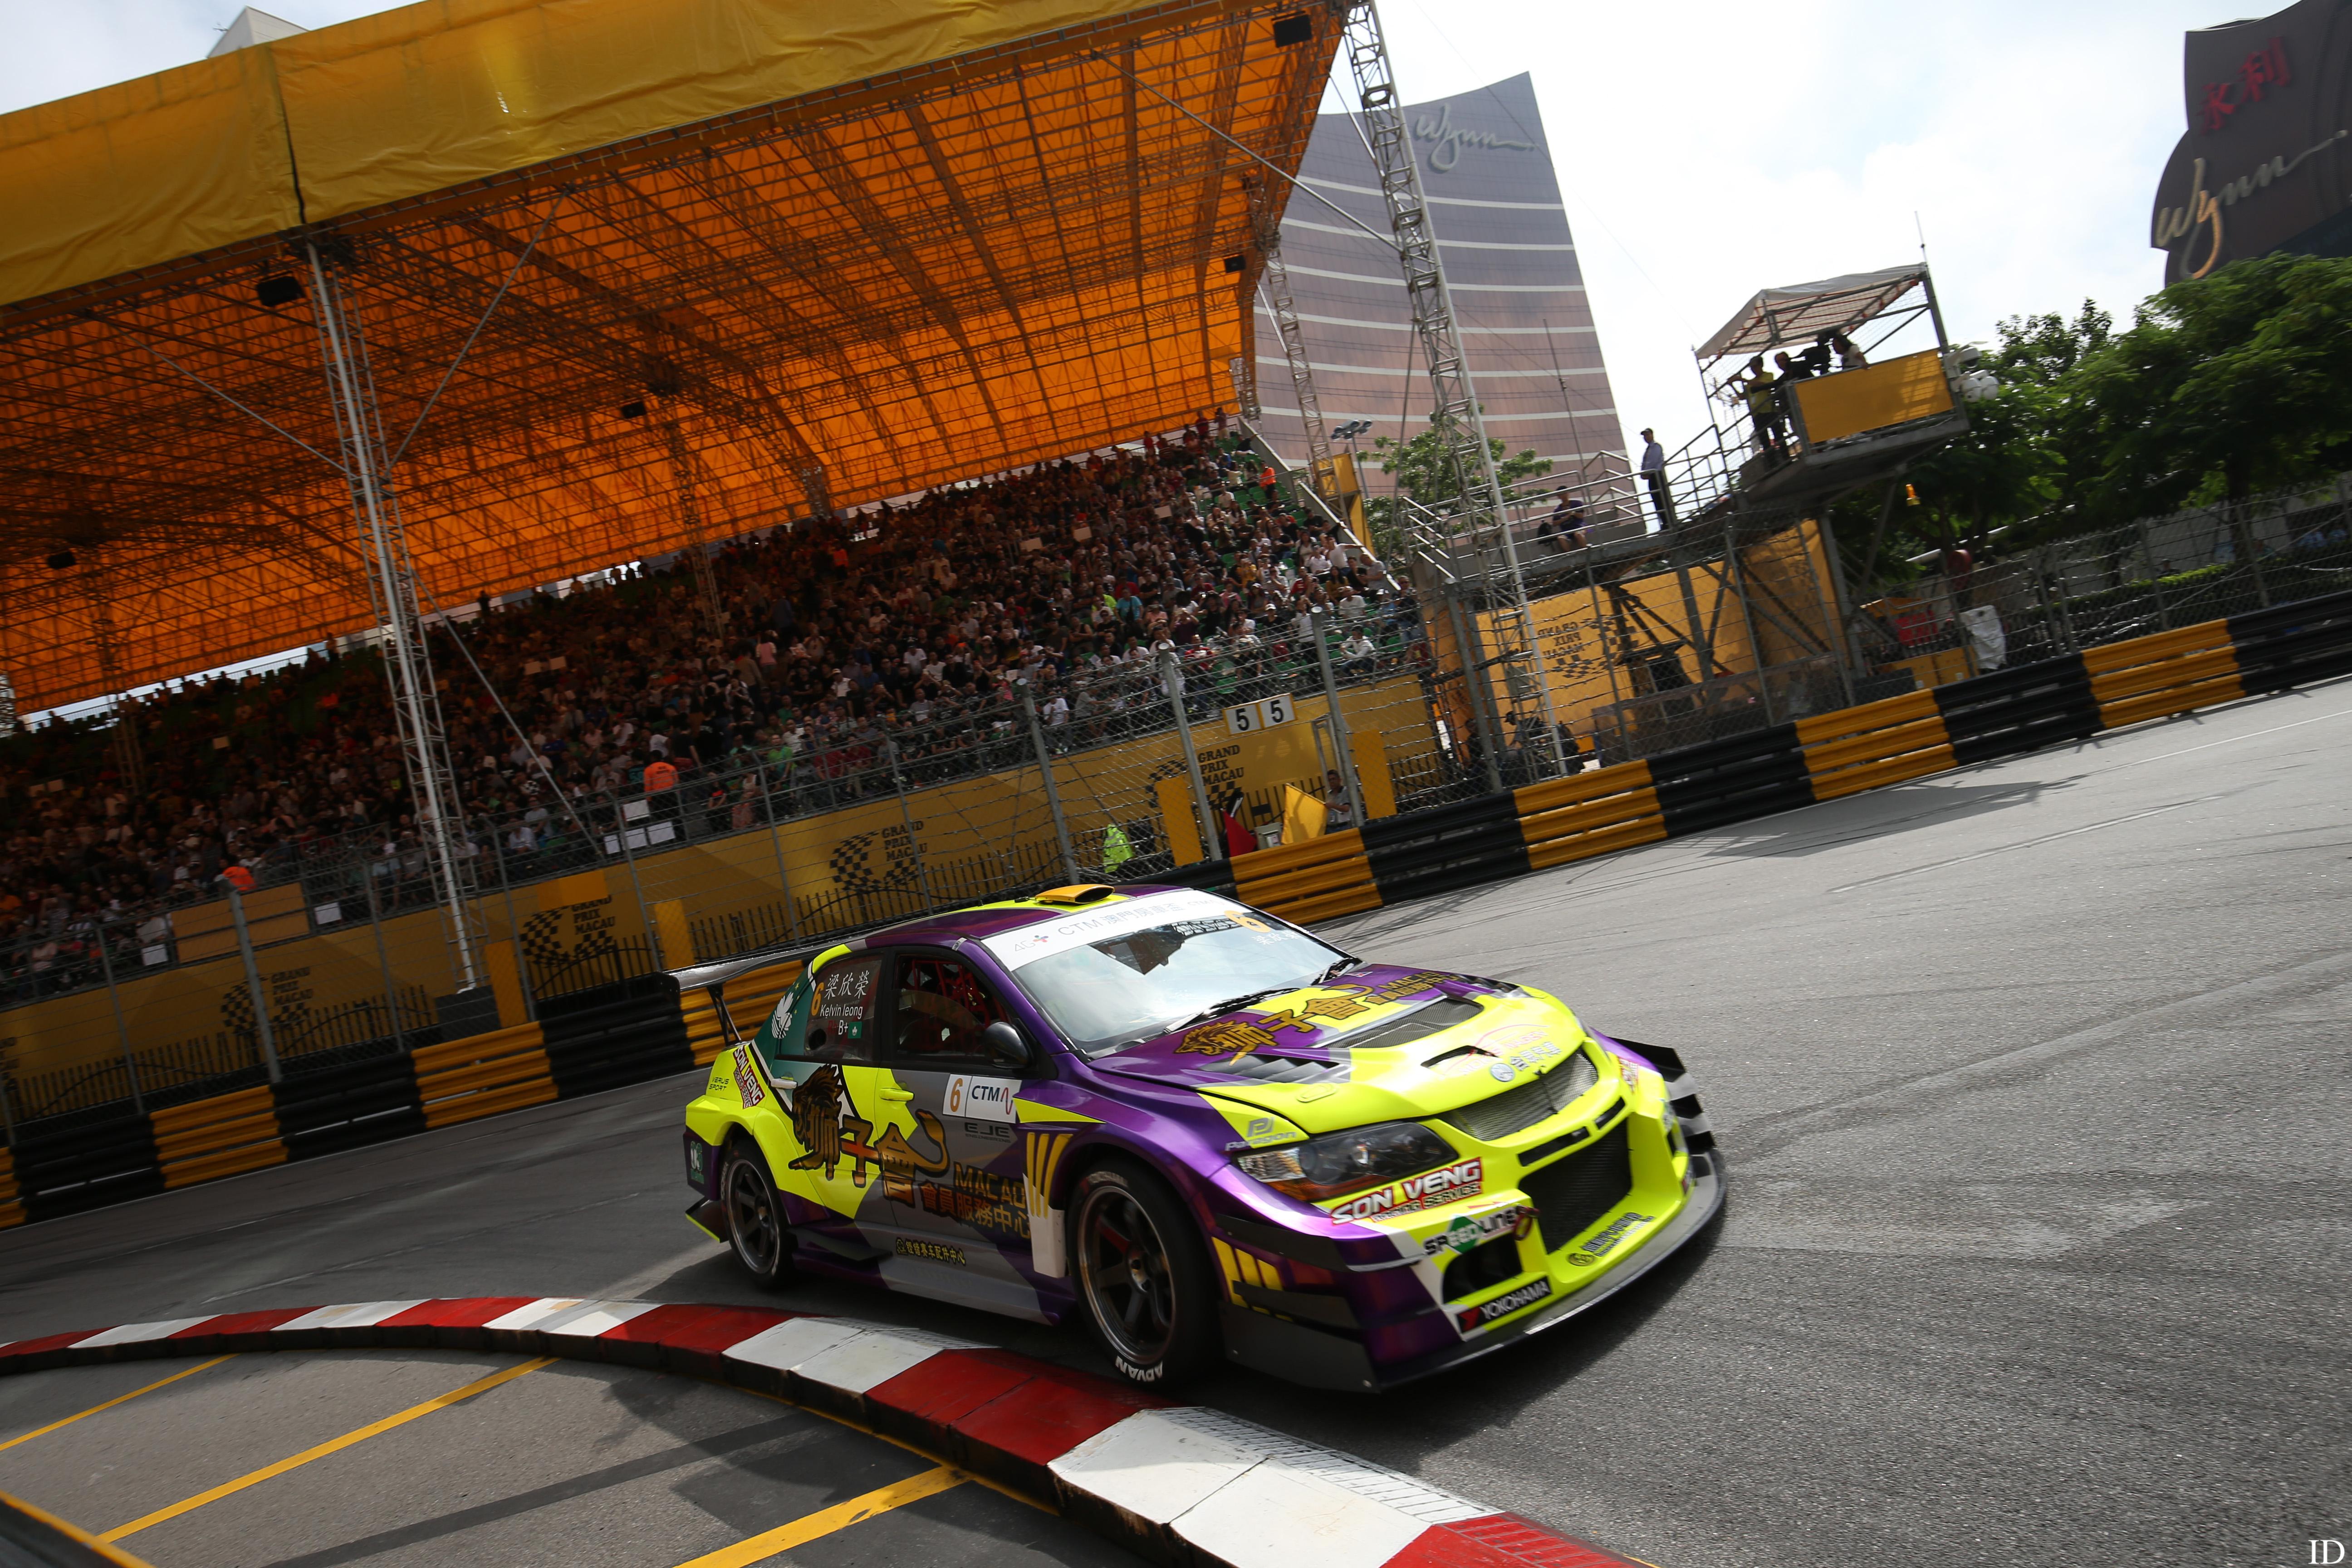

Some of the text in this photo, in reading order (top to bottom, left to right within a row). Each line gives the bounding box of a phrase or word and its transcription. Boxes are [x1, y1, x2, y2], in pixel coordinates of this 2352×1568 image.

[2195, 36, 2291, 134] 永利
[1236, 699, 1284, 731] 5 5
[1198, 745, 1240, 763] GRAND
[1200, 759, 1229, 774] PRIX
[1202, 767, 1244, 786] MACAU
[887, 843, 928, 861] MACU
[573, 908, 602, 923] PRIX
[1224, 909, 1271, 933] 6
[574, 916, 616, 935] MACAU
[1058, 919, 1103, 936] CTM
[271, 966, 310, 983] GRAND
[273, 980, 299, 995] PRIX
[824, 970, 870, 1000] 梁欣榮
[274, 988, 313, 1006] MACAU
[811, 982, 824, 1016] 6
[820, 1004, 842, 1017] Kelvin
[838, 1019, 848, 1035] B+
[734, 1045, 748, 1071] SON
[712, 1077, 730, 1085] VERUS
[950, 1078, 963, 1112] 6
[971, 1085, 1000, 1102] CTM
[1331, 1161, 1480, 1224] SON VENG
[1480, 1280, 1552, 1320] YOKOHAMA
[1115, 1355, 1163, 1382] ADVAN
